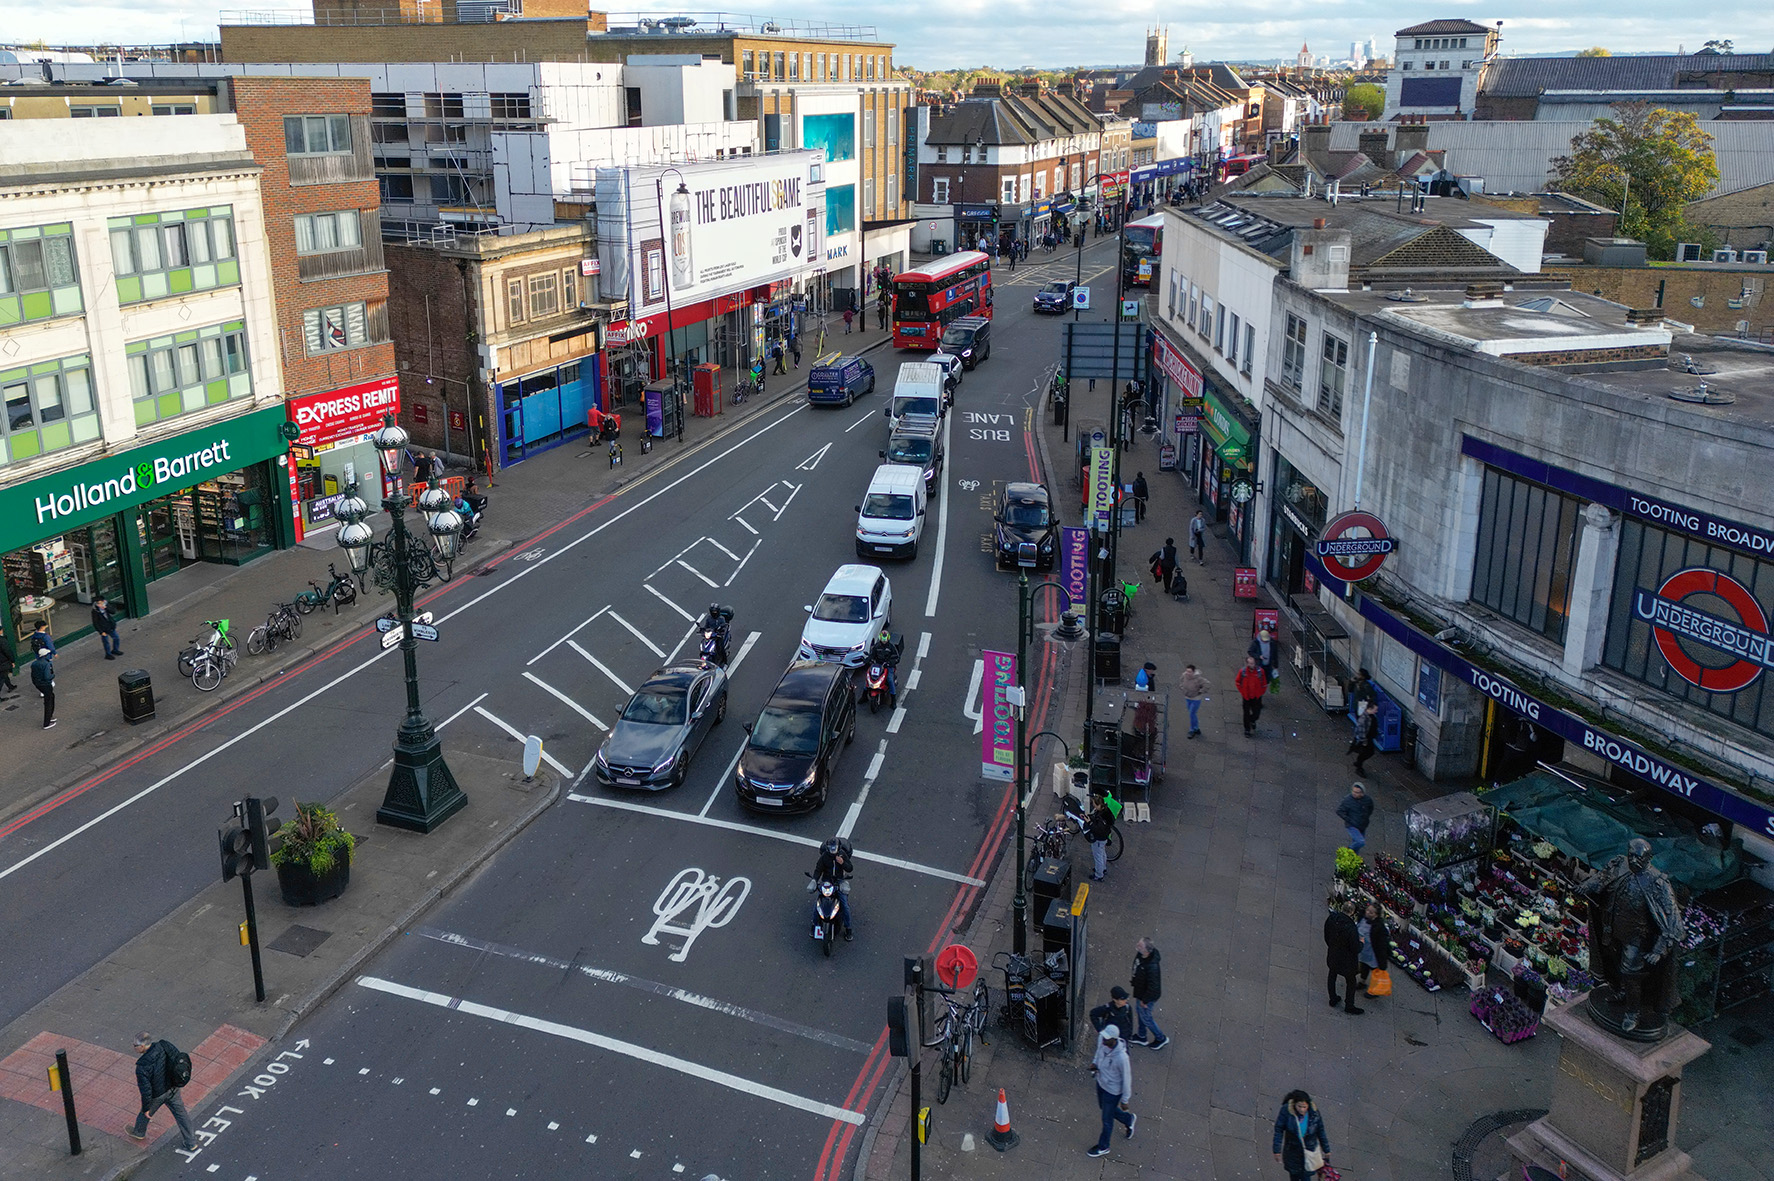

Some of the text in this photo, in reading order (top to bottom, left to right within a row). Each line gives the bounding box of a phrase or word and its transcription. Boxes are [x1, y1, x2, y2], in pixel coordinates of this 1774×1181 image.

[908, 126, 916, 182] PRIMARK
[695, 189, 717, 225] THE
[720, 181, 772, 221] BEAUTIFUL
[295, 395, 360, 425] EXPRESS
[962, 411, 1015, 425] LANE
[969, 428, 1010, 441] BUS
[1095, 450, 1111, 508] TOOTING
[1283, 504, 1309, 537] STARBUCKS
[1631, 496, 1700, 531] TOOTING
[1070, 530, 1086, 601] TOOTING
[1318, 540, 1392, 555] UNDERGROUND
[993, 656, 1012, 745] TOOTING
[1471, 668, 1540, 721] TOOTING
[1583, 729, 1698, 797] BROADWAY
[237, 1050, 304, 1100] LOOK
[175, 1105, 245, 1164] LEFT
